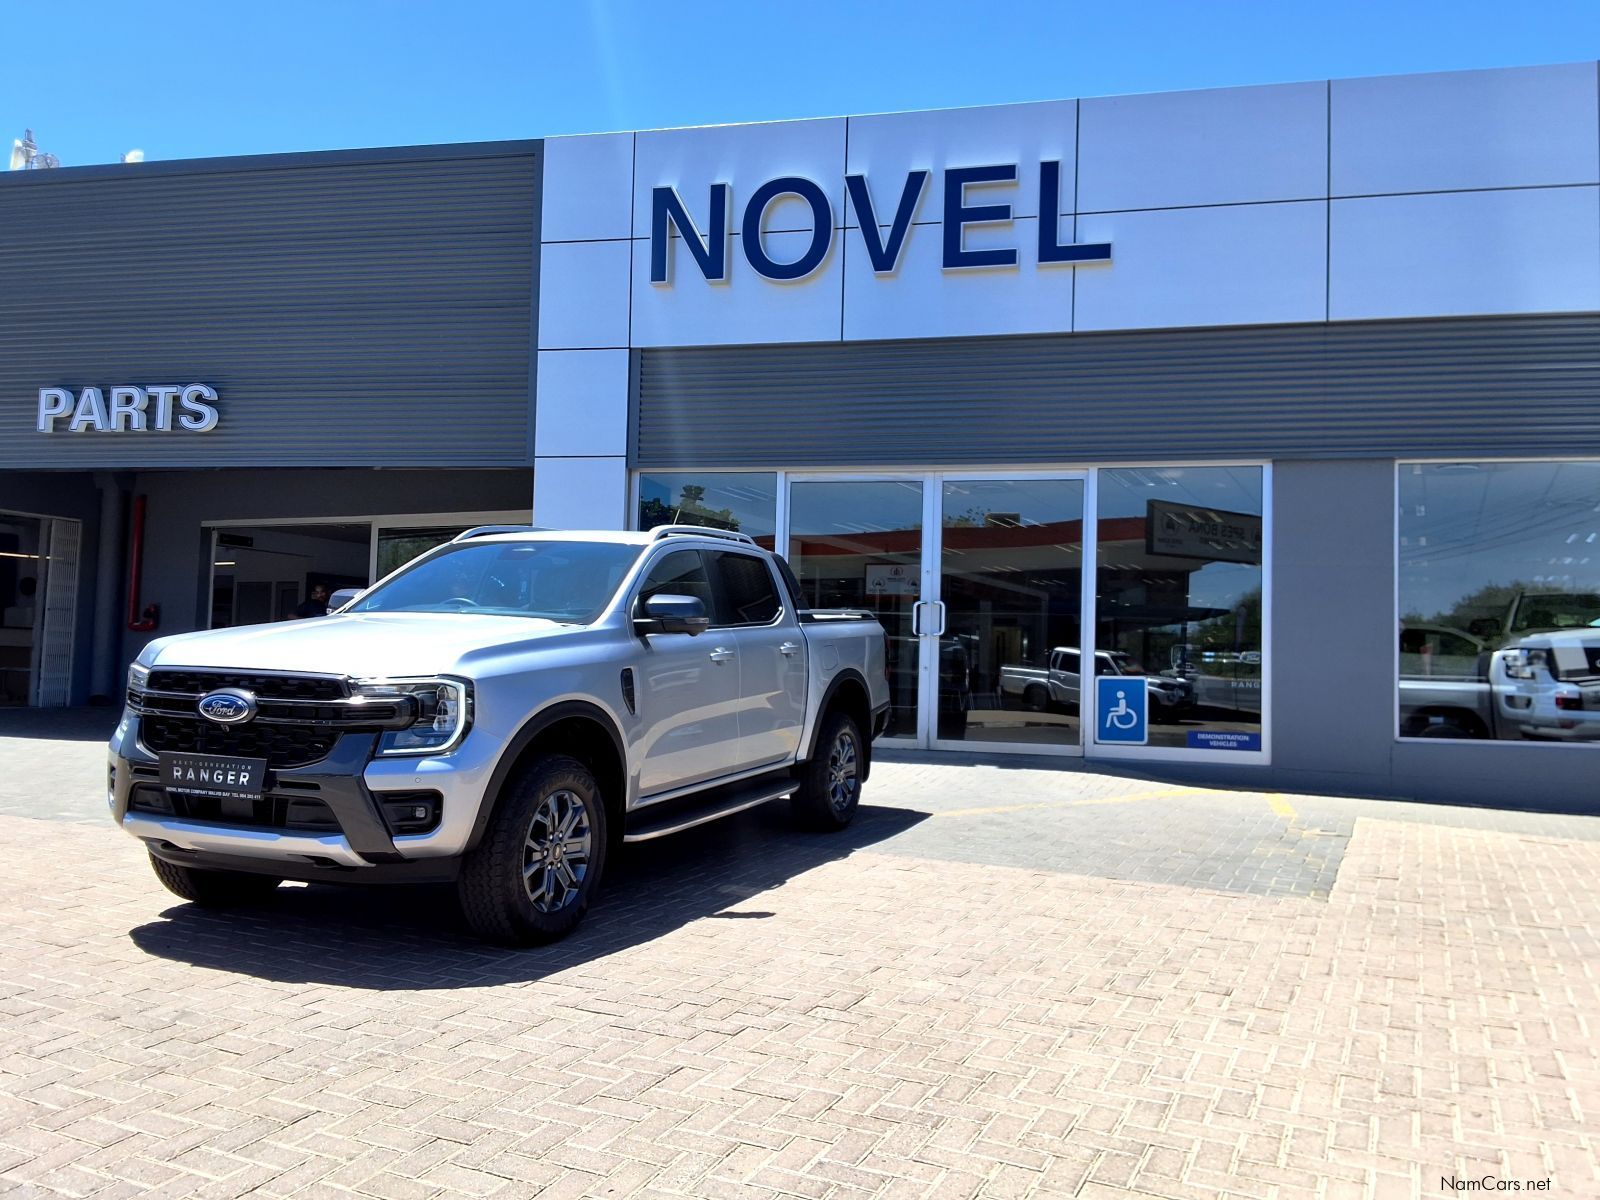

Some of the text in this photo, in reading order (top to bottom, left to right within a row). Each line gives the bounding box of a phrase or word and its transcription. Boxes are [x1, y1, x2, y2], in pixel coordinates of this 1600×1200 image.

[650, 160, 1112, 285] NOVEL
[37, 382, 219, 433] PARTS
[205, 700, 236, 716] Ford
[1197, 733, 1249, 741] DEMONSTRATION
[173, 766, 250, 786] RANGER
